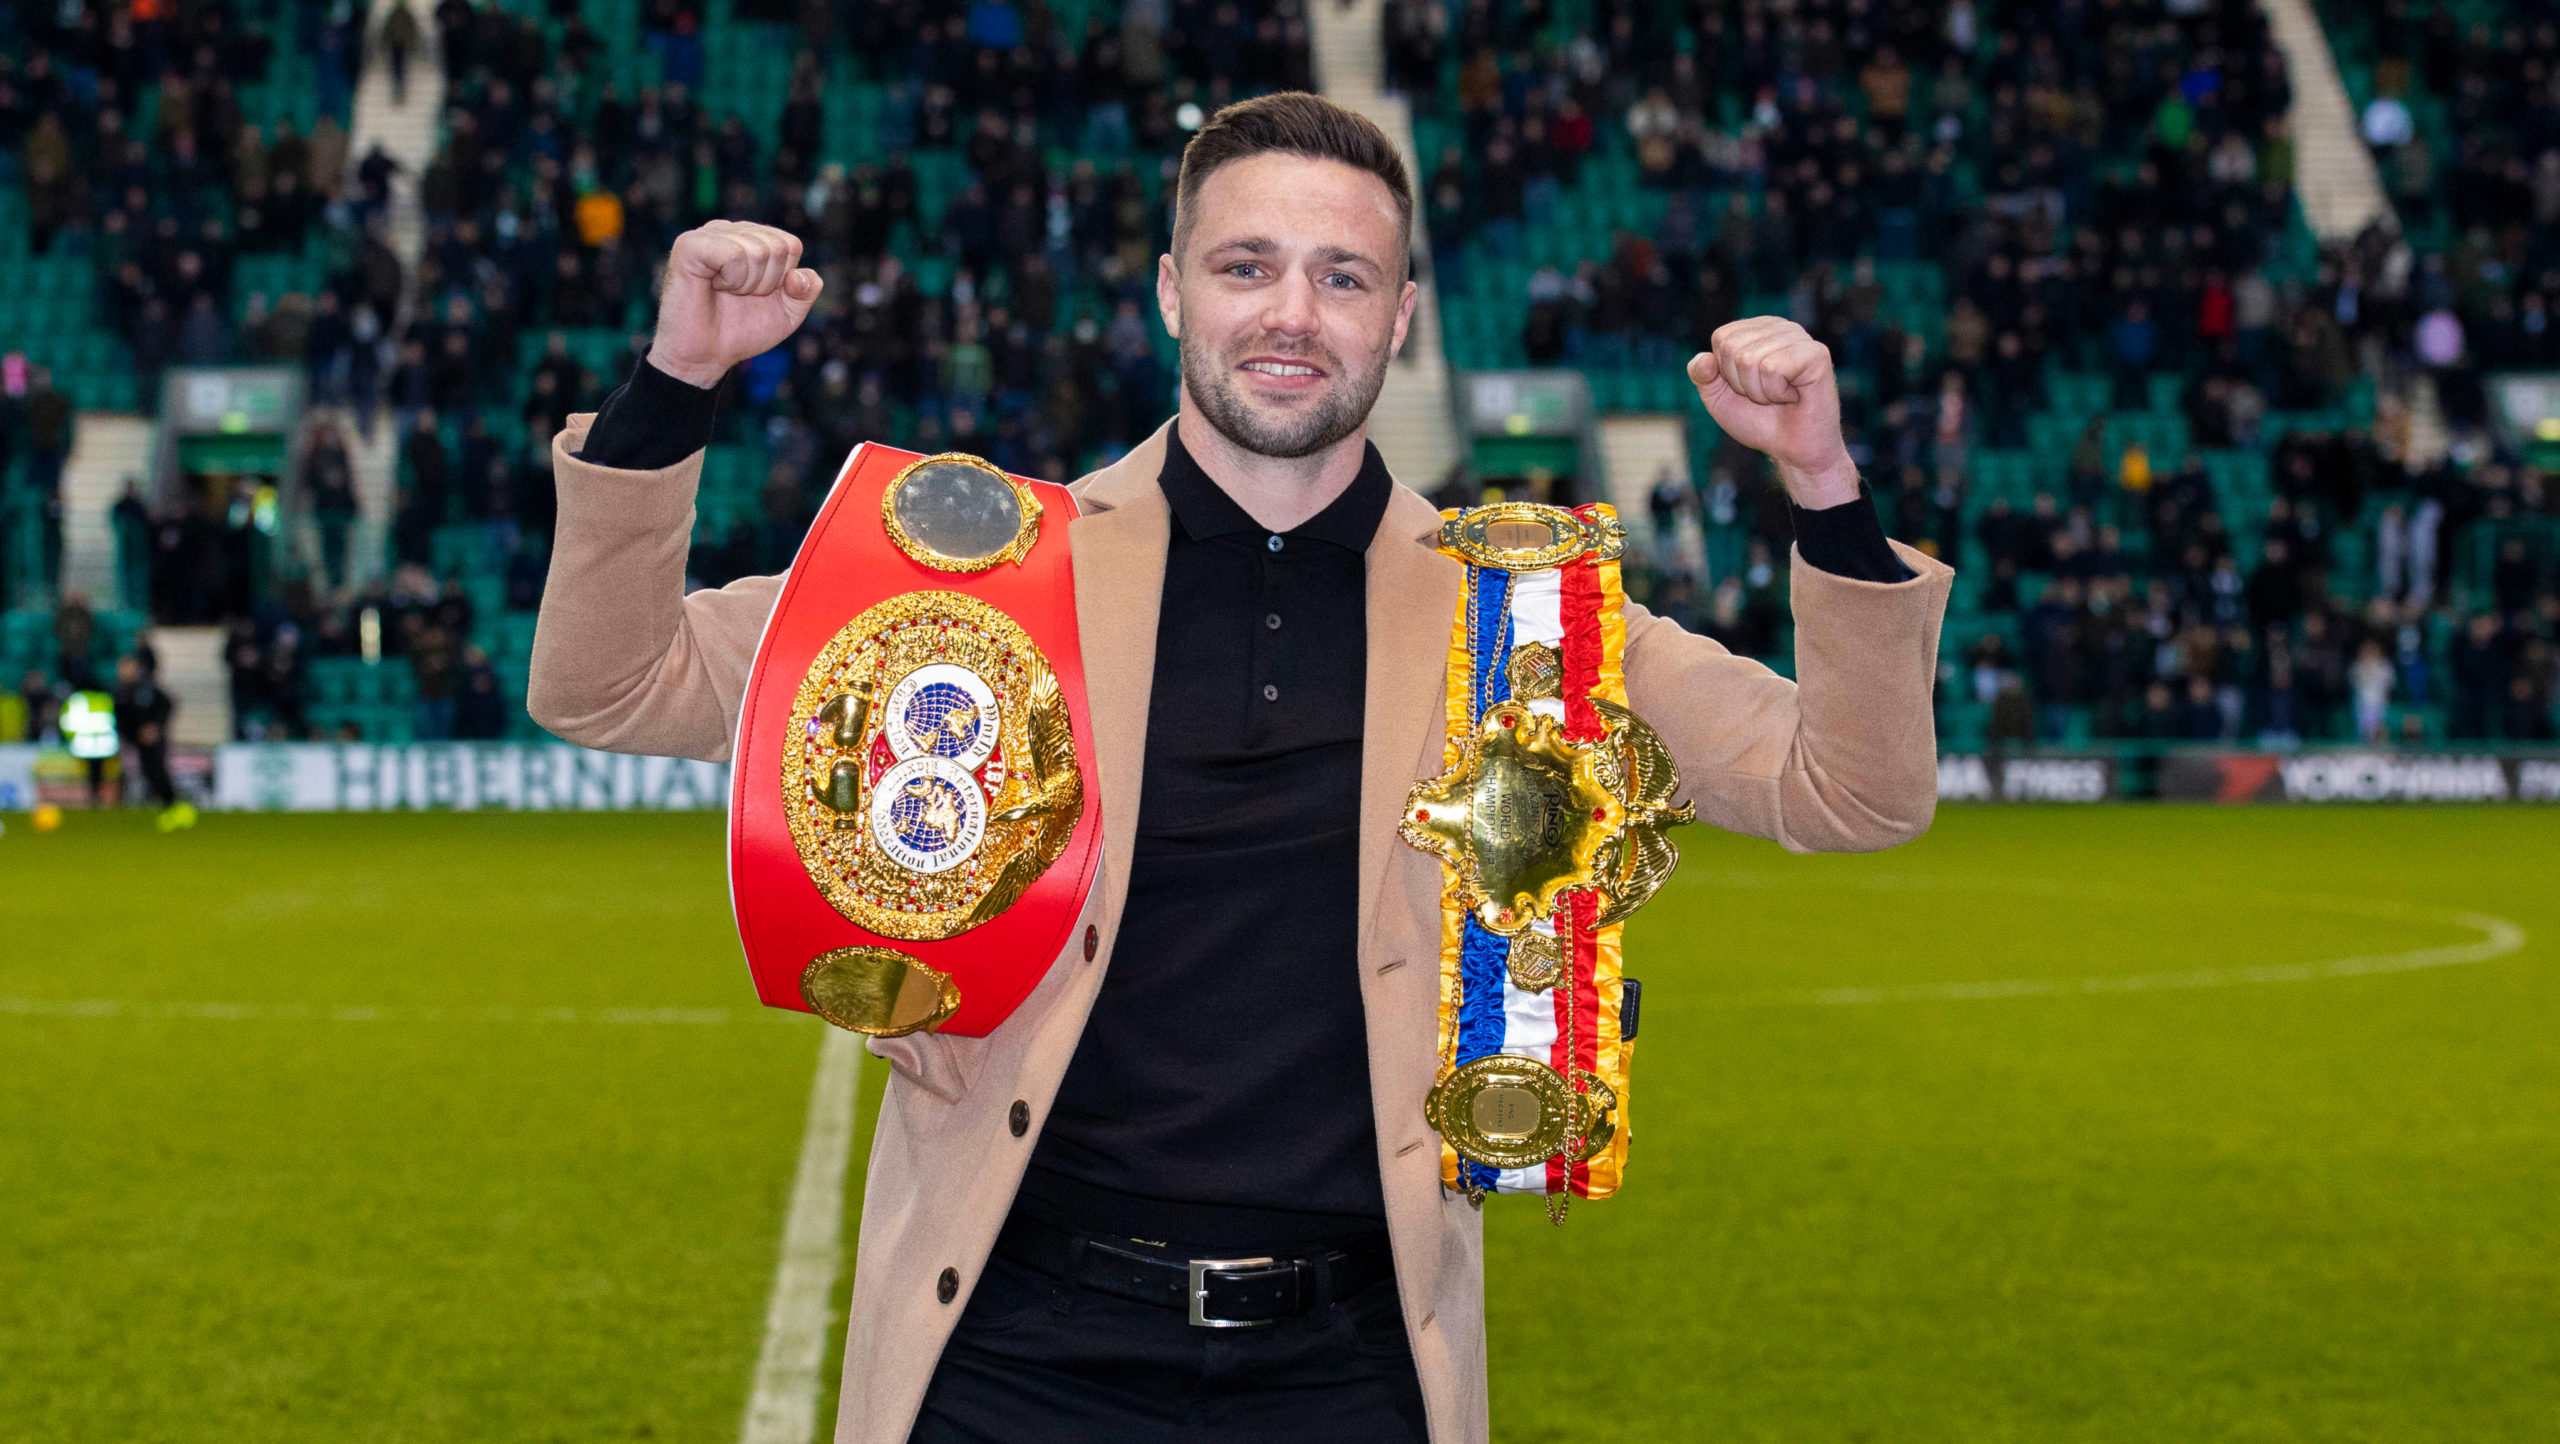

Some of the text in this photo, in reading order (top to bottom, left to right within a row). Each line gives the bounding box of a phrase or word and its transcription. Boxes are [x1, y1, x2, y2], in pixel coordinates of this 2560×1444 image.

[973, 703, 998, 758] World
[983, 761, 1003, 797] IBF
[2279, 755, 2510, 801] YOKOHAMA
[1485, 767, 1497, 866] CHAMPIONSHIP
[1500, 793, 1512, 840] WORLD
[1543, 789, 1565, 847] RING
